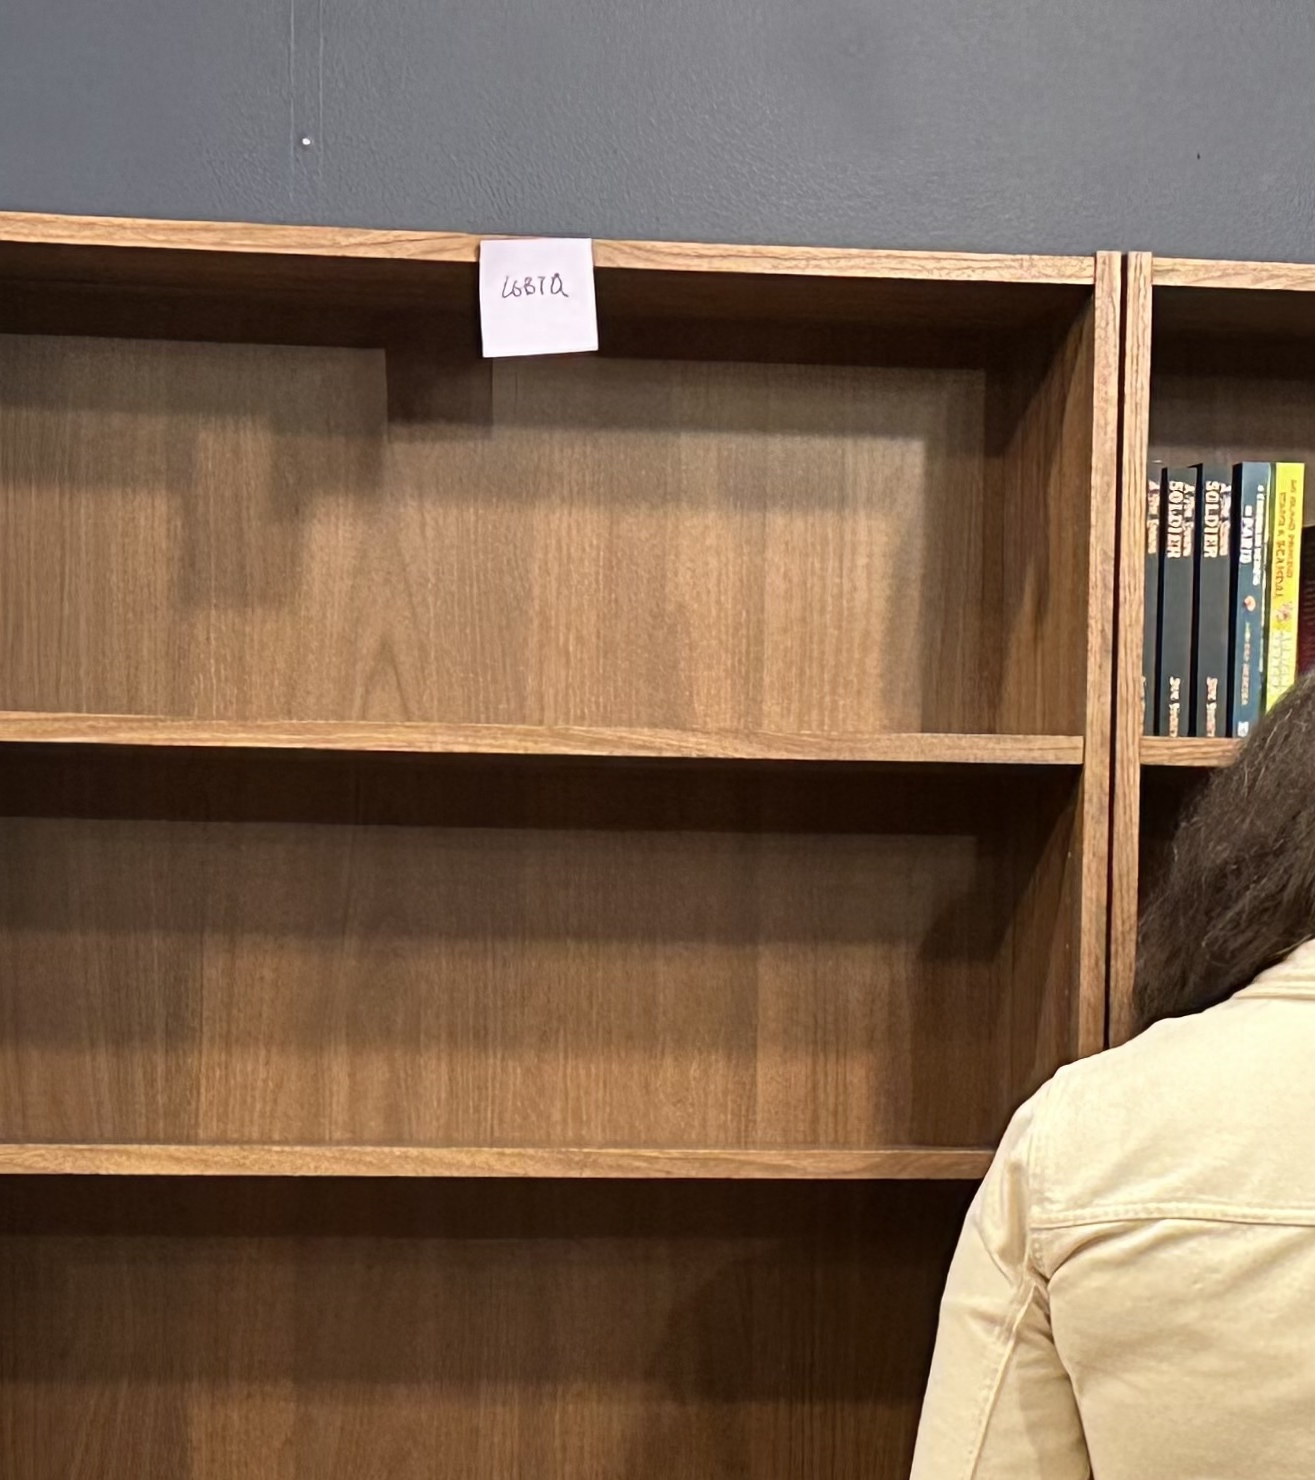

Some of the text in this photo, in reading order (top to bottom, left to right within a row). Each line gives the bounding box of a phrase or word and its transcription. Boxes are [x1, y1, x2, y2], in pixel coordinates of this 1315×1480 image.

[501, 272, 569, 299] LGBTQ
[1167, 480, 1184, 558] SOLDIER
[1203, 480, 1219, 558] SOLDIER
